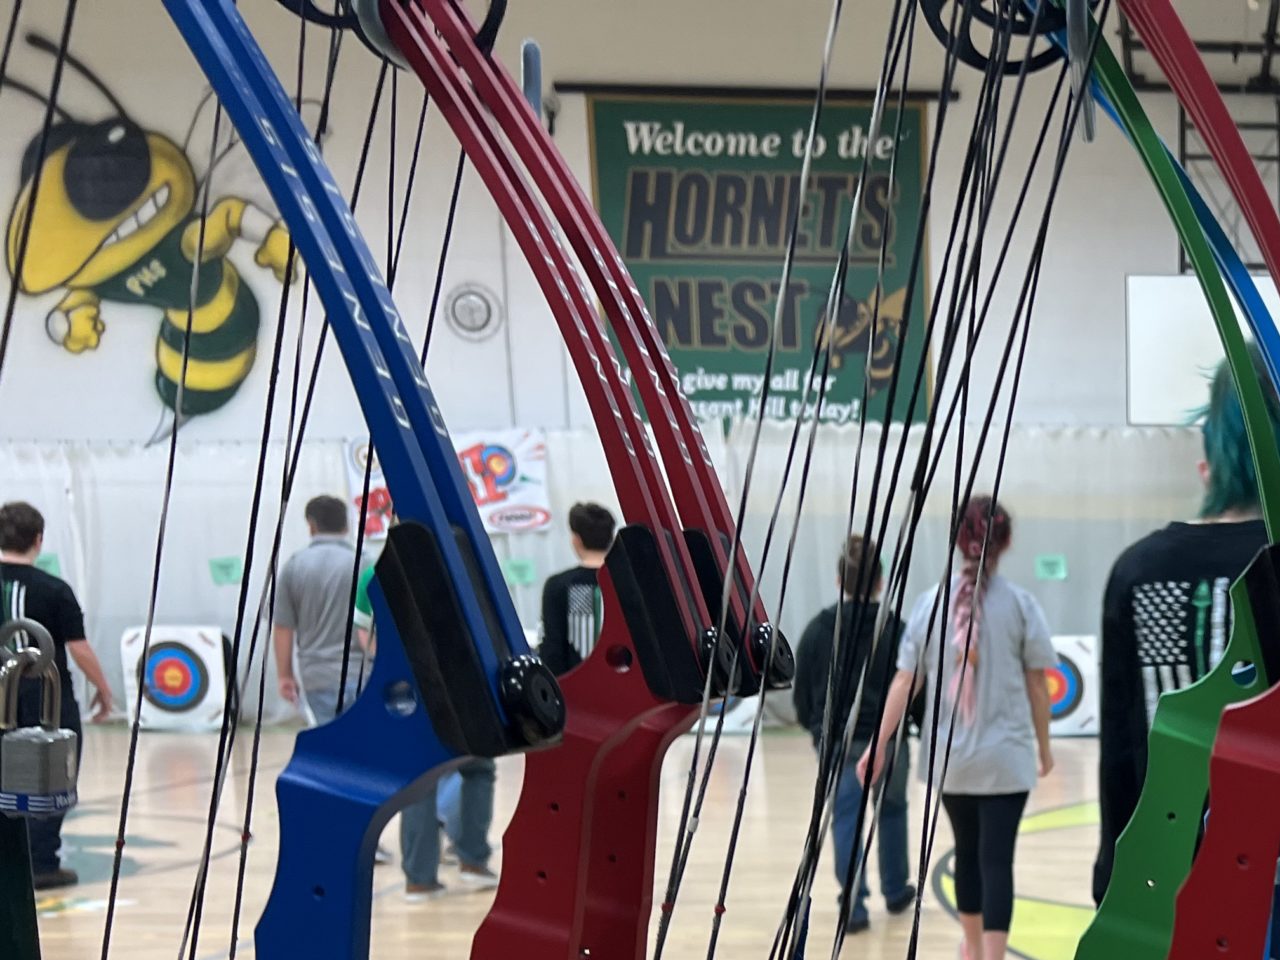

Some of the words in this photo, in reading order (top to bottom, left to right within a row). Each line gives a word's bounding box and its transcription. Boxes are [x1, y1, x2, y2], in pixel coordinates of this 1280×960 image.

[624, 121, 782, 159] Welcome
[791, 129, 828, 159] to
[837, 126, 894, 160] the
[651, 274, 808, 352] NEST
[682, 367, 728, 394] give
[731, 373, 767, 395] my
[769, 368, 800, 391] all
